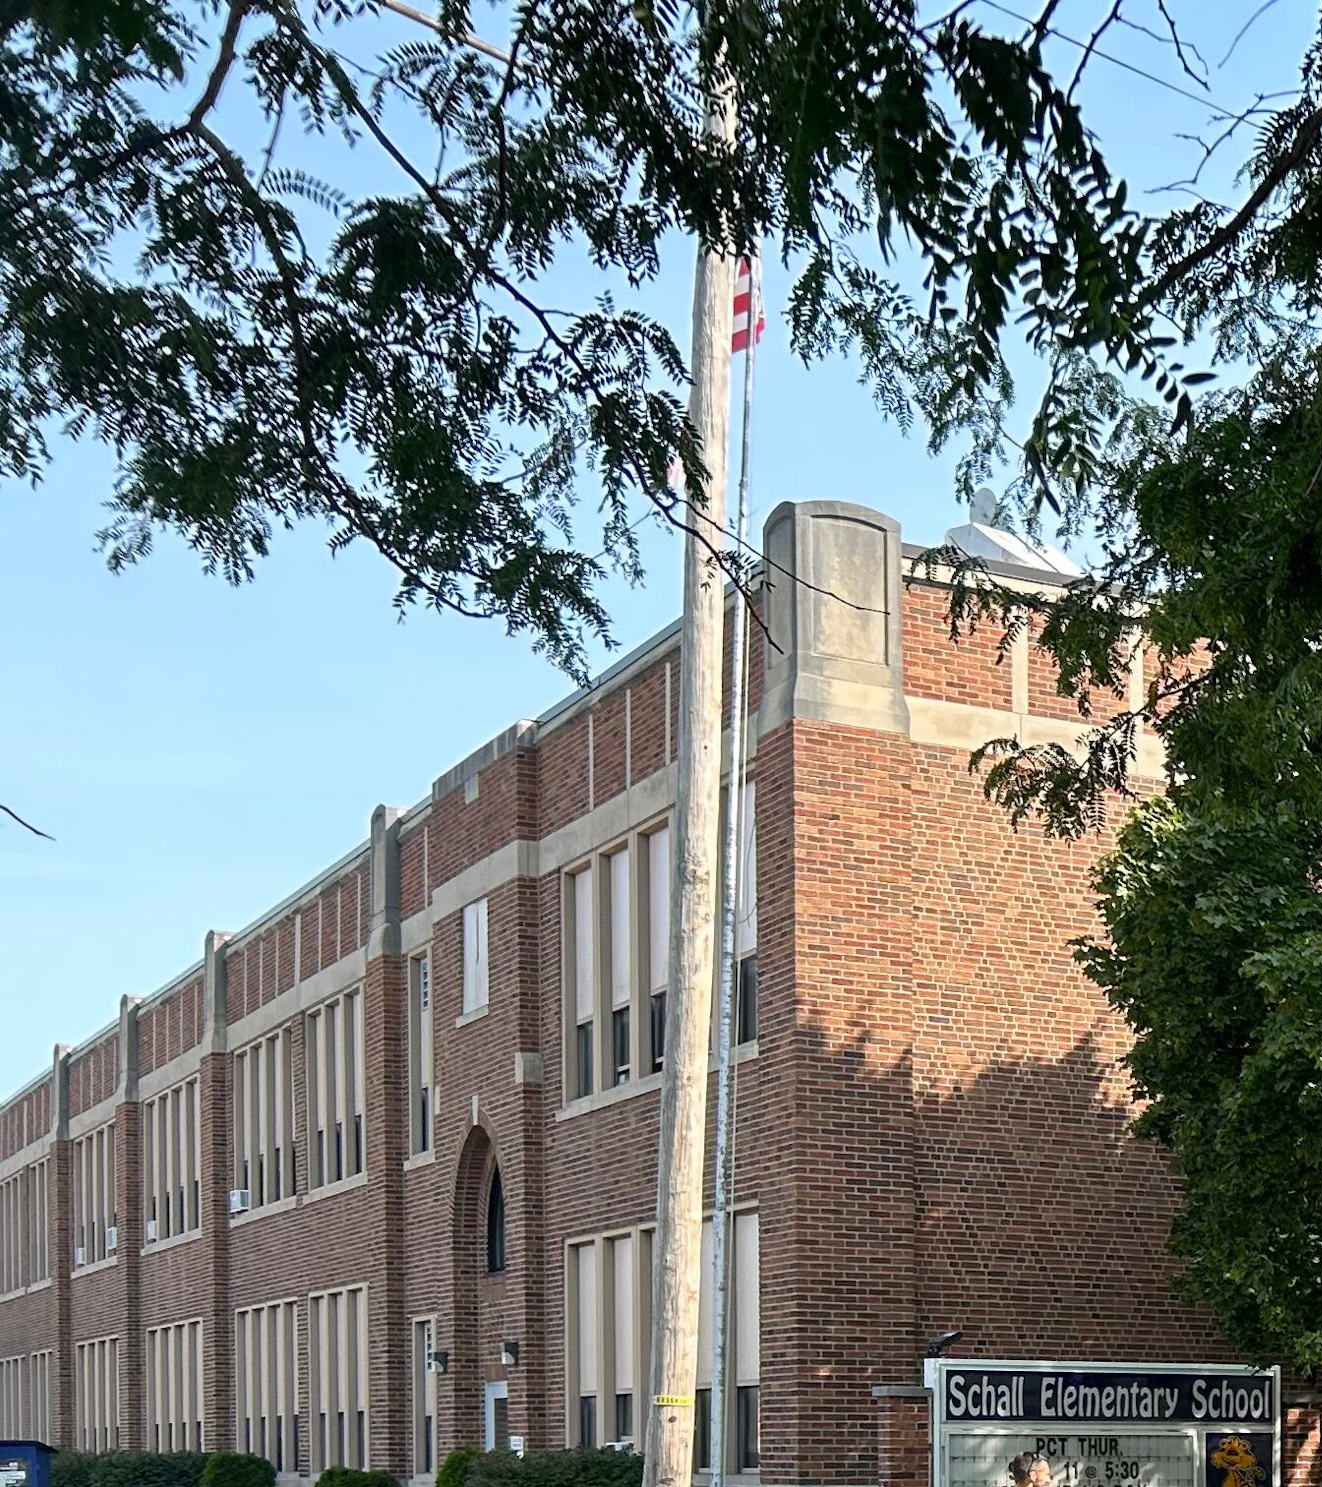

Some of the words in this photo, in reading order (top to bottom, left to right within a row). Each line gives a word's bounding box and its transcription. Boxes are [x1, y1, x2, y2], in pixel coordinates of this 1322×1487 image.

[949, 1375, 1024, 1416] Schall
[1040, 1377, 1179, 1418] Elementary
[1191, 1379, 1271, 1419] School
[1036, 1437, 1068, 1456] PCT
[1064, 1461, 1078, 1480] 11
[1085, 1465, 1097, 1479] @
[1105, 1461, 1139, 1480] 5:30
